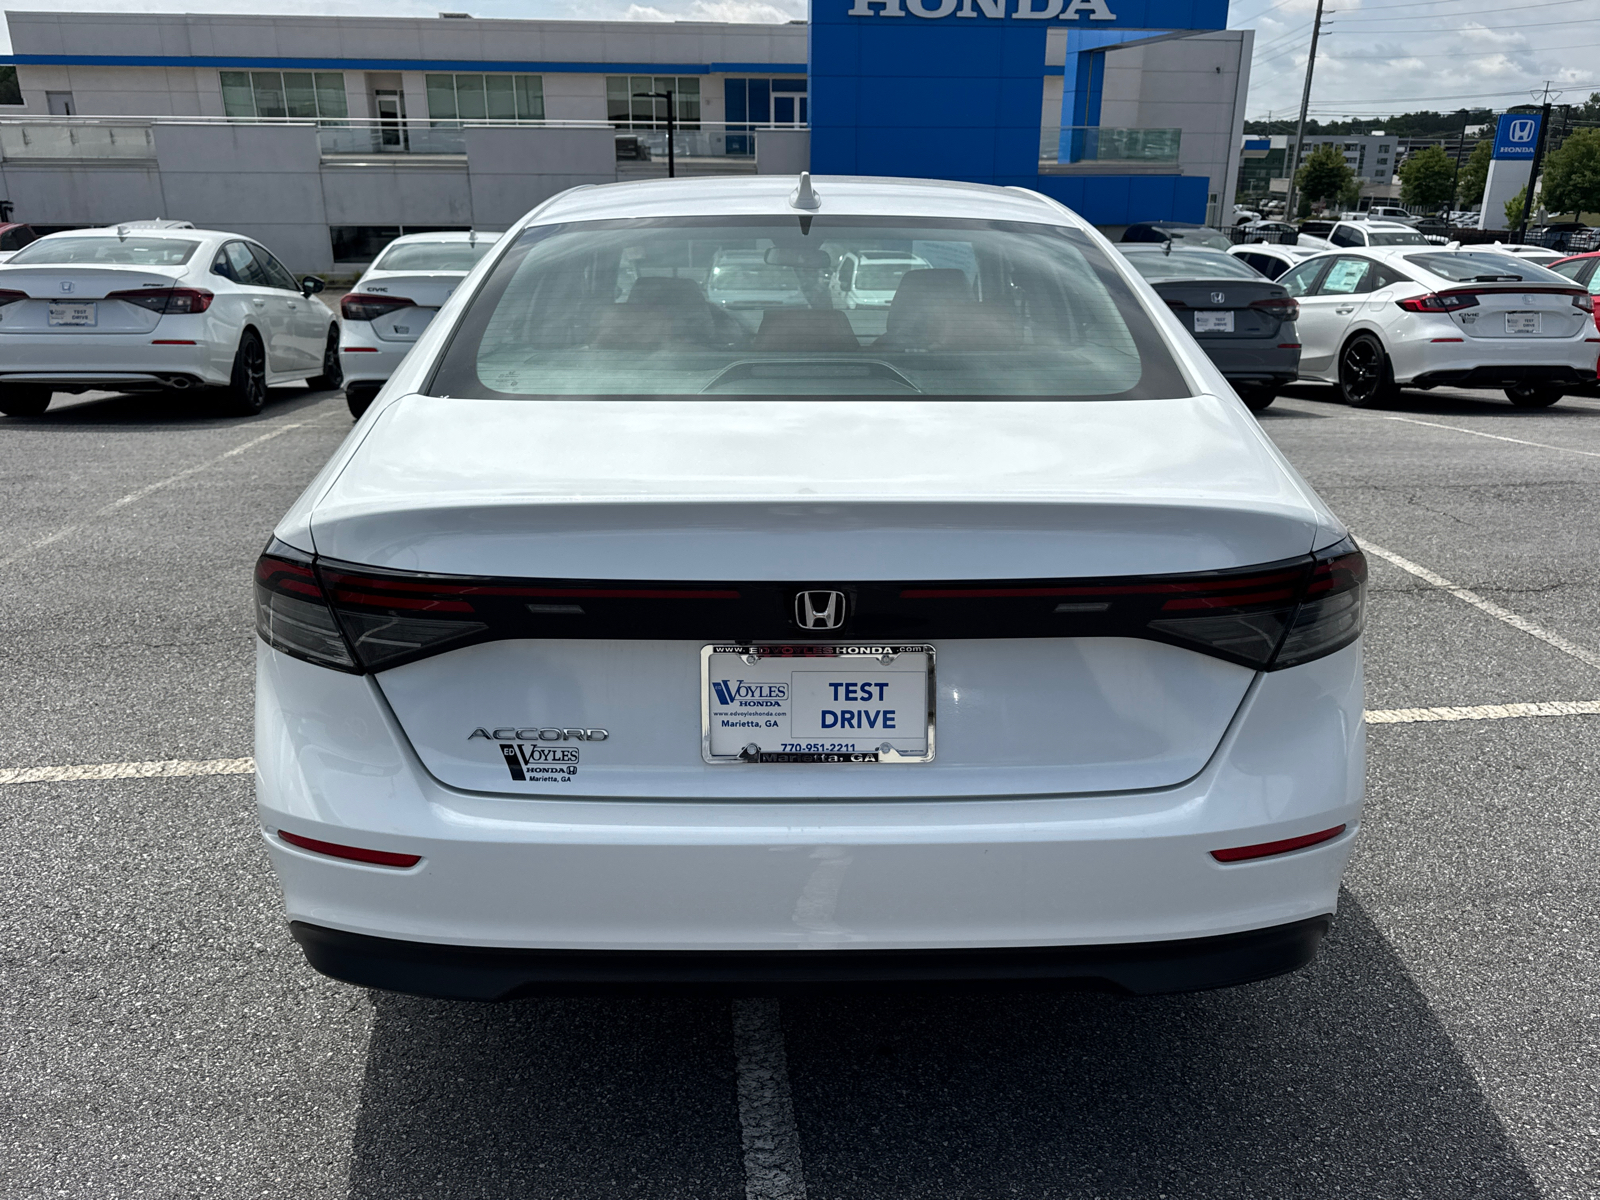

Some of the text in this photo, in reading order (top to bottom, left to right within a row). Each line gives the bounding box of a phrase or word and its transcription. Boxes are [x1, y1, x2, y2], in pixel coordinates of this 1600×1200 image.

[721, 680, 786, 703] VOYLES
[828, 682, 889, 702] TEST
[721, 719, 779, 728] Marietta, GA
[821, 709, 896, 729] DRIVE
[467, 727, 610, 741] ACCORD
[503, 744, 578, 766] ED VOYLES
[780, 743, 856, 752] 770-951-2211
[762, 753, 876, 762] Marietta, GA
